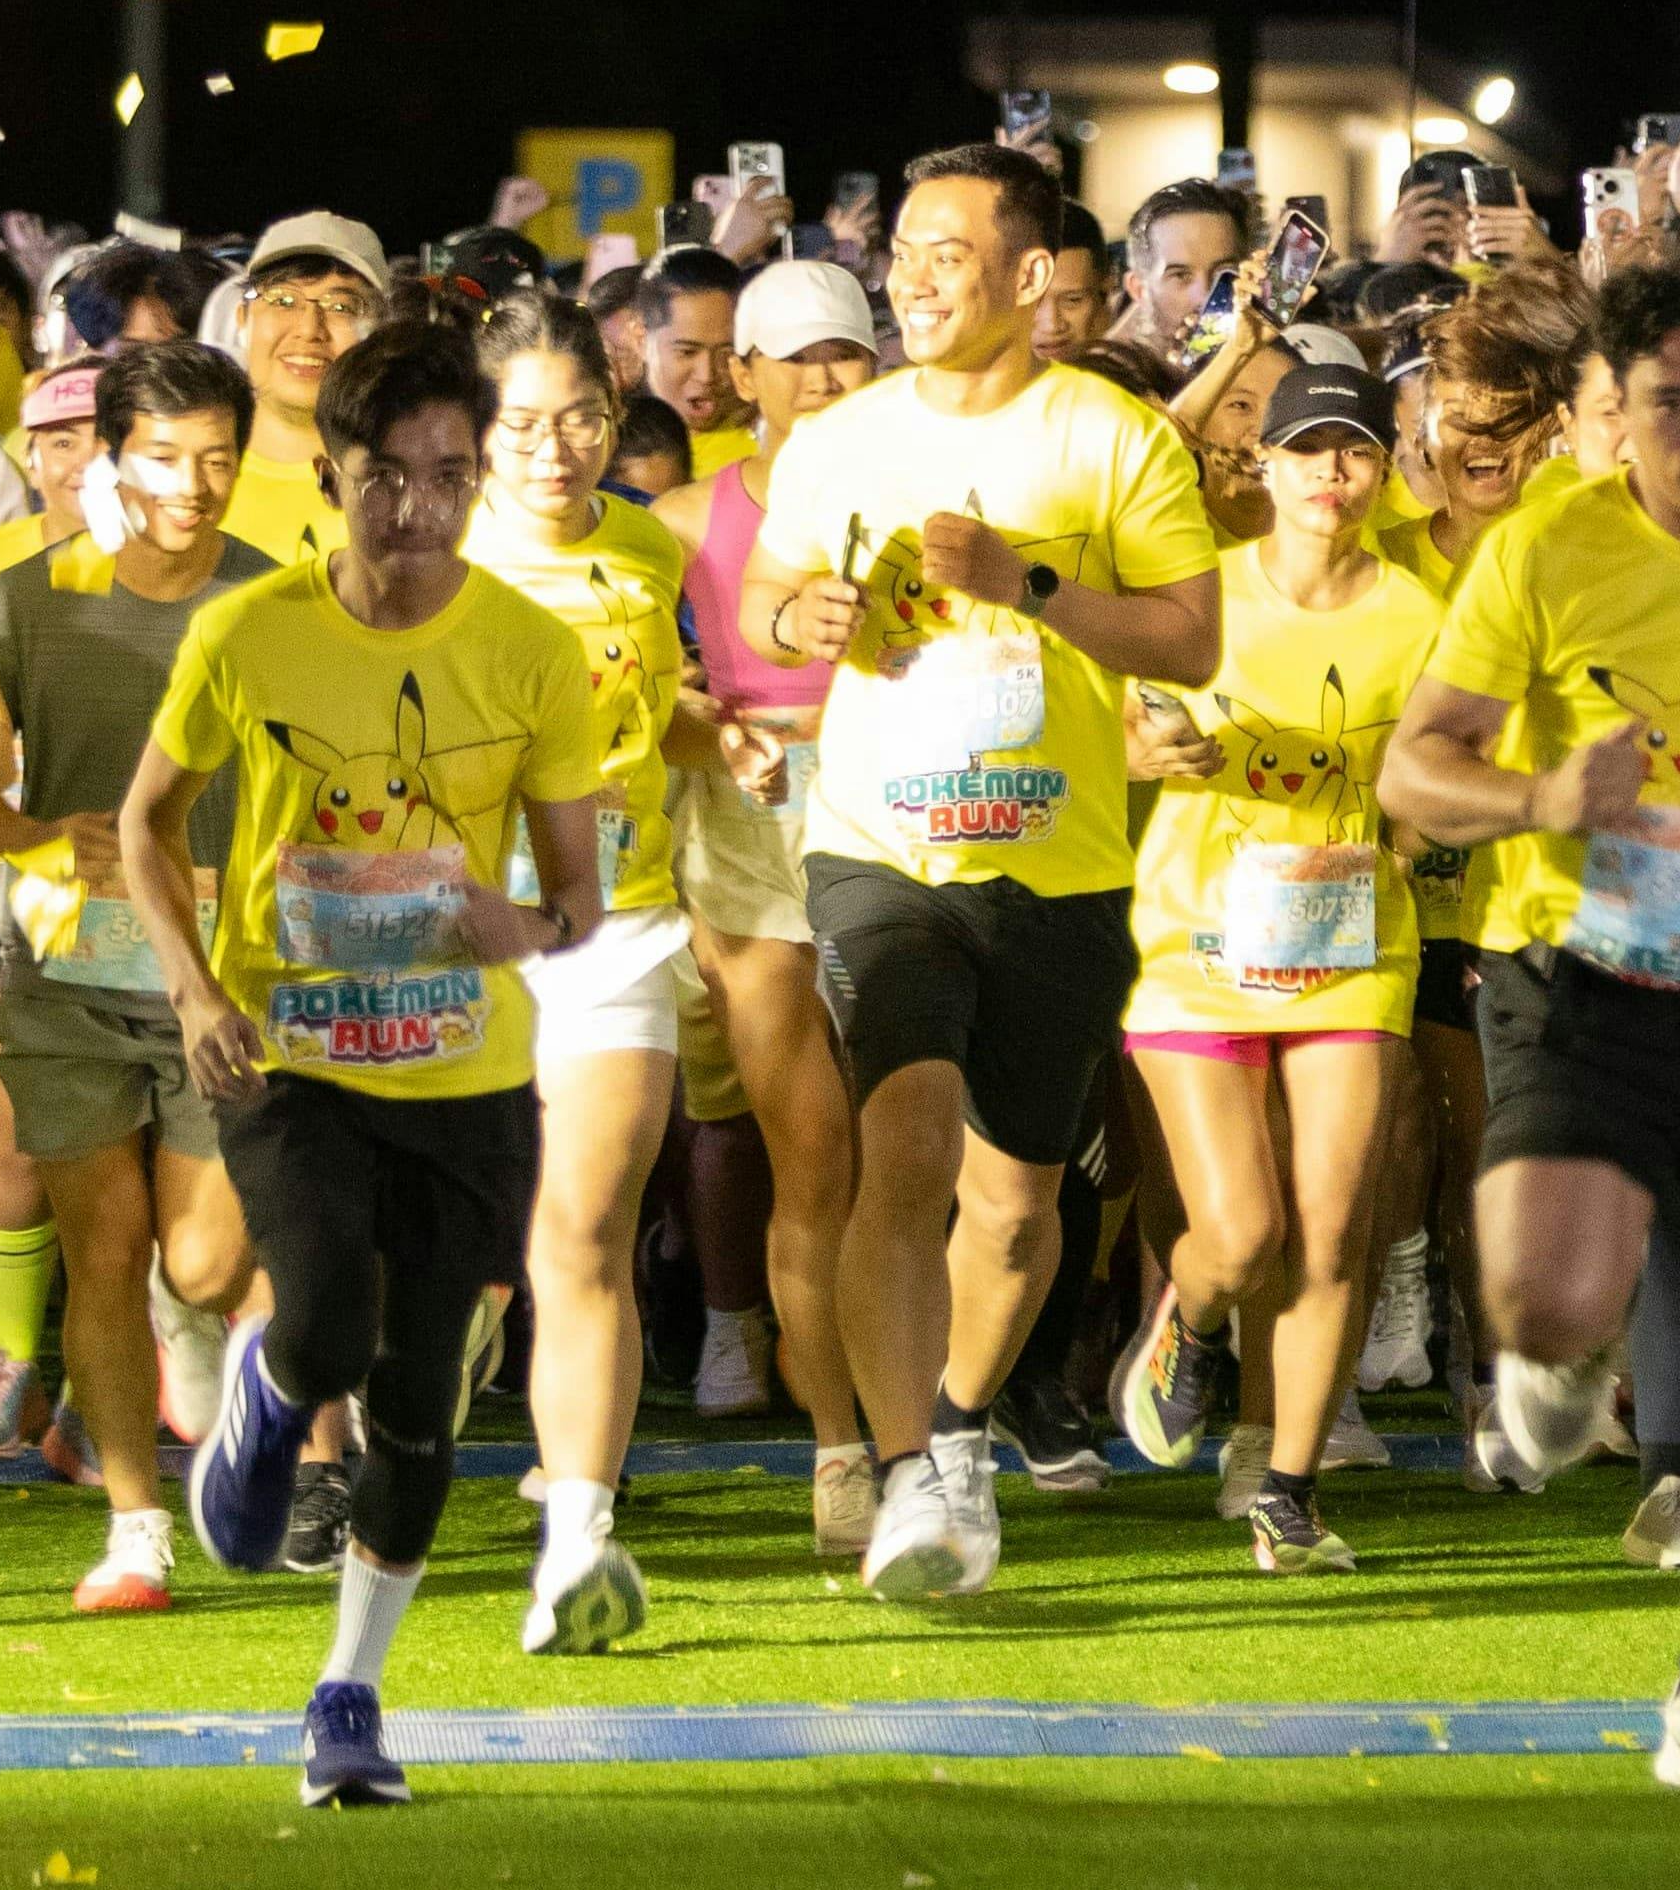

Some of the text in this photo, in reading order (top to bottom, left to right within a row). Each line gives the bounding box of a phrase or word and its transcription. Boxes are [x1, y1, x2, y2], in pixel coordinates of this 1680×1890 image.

[579, 159, 643, 238] P
[929, 801, 1021, 834] RUN
[331, 1016, 434, 1056] RUN
